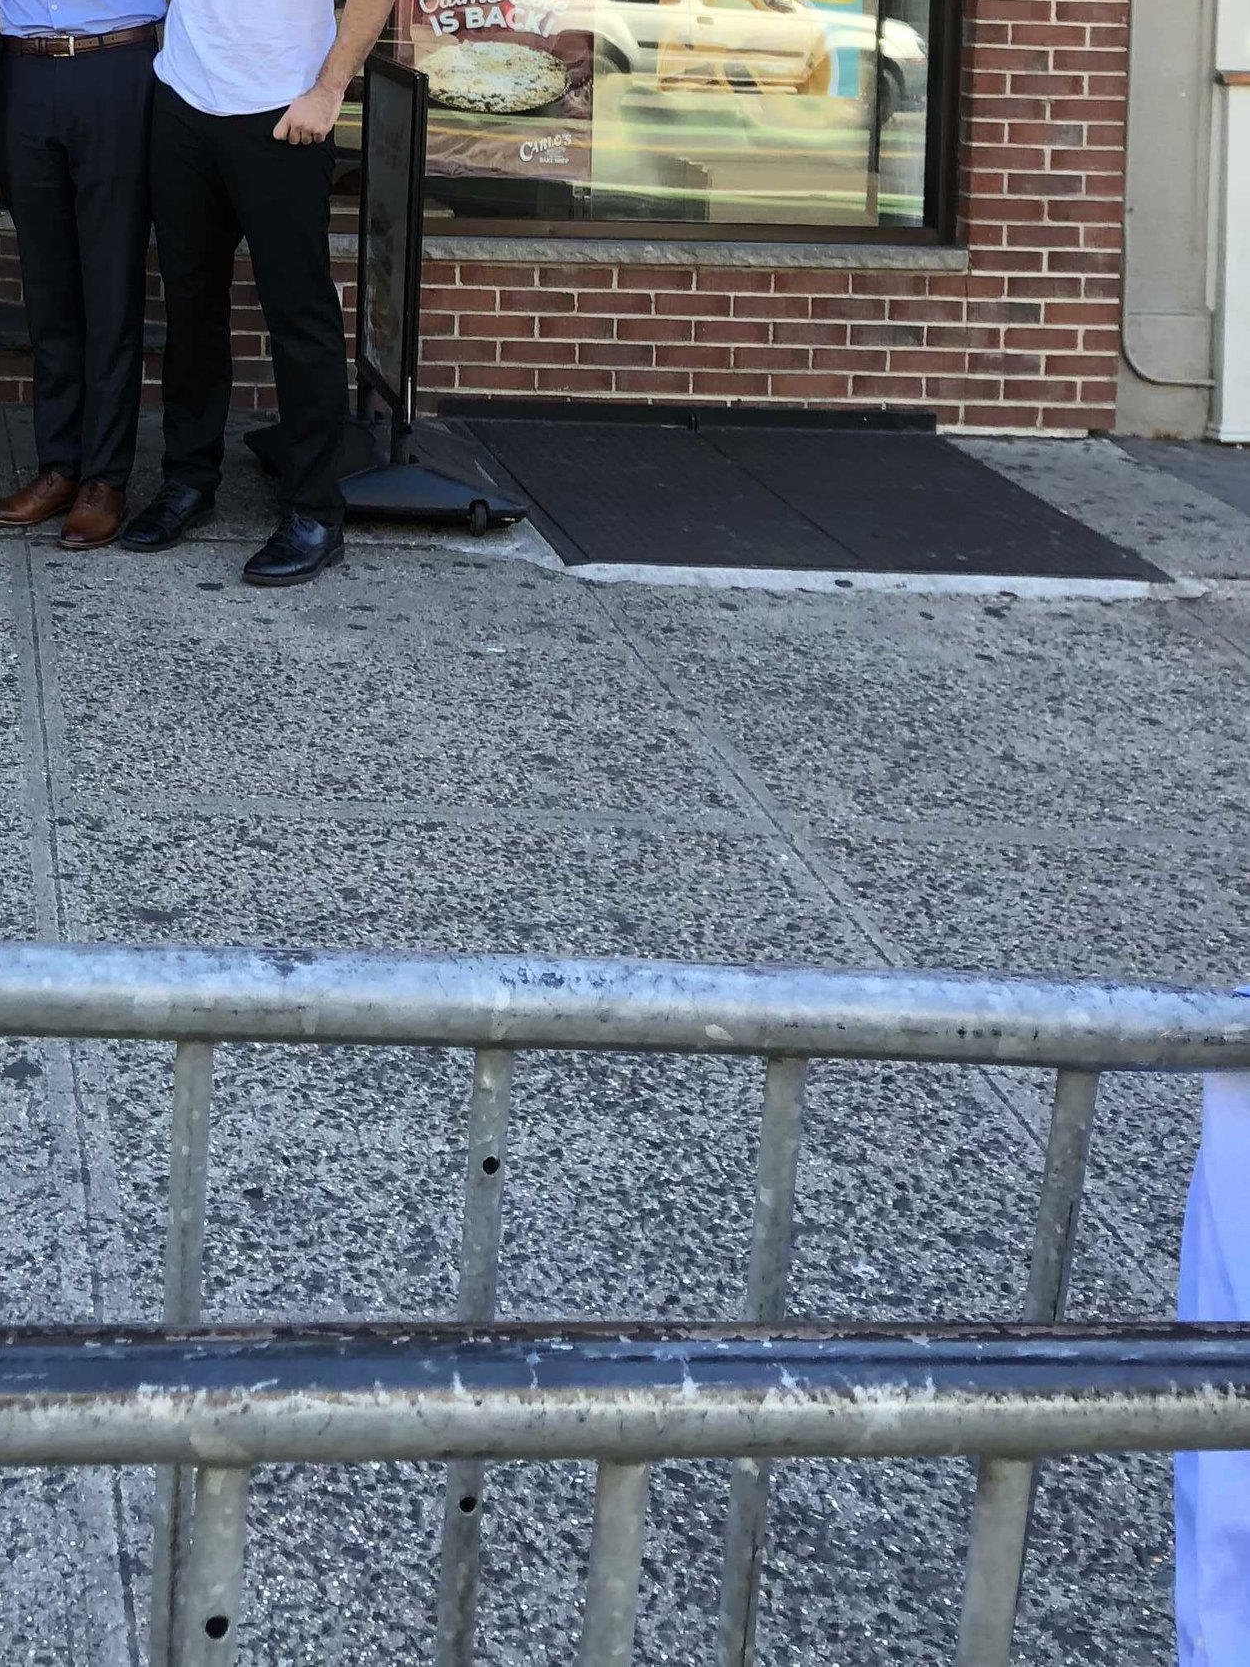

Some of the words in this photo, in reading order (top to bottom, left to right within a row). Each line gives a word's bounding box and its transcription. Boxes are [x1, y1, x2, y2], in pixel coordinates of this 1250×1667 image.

[429, 11, 460, 37] IS
[465, 6, 556, 38] BACK!
[520, 133, 572, 162] CARLO'S
